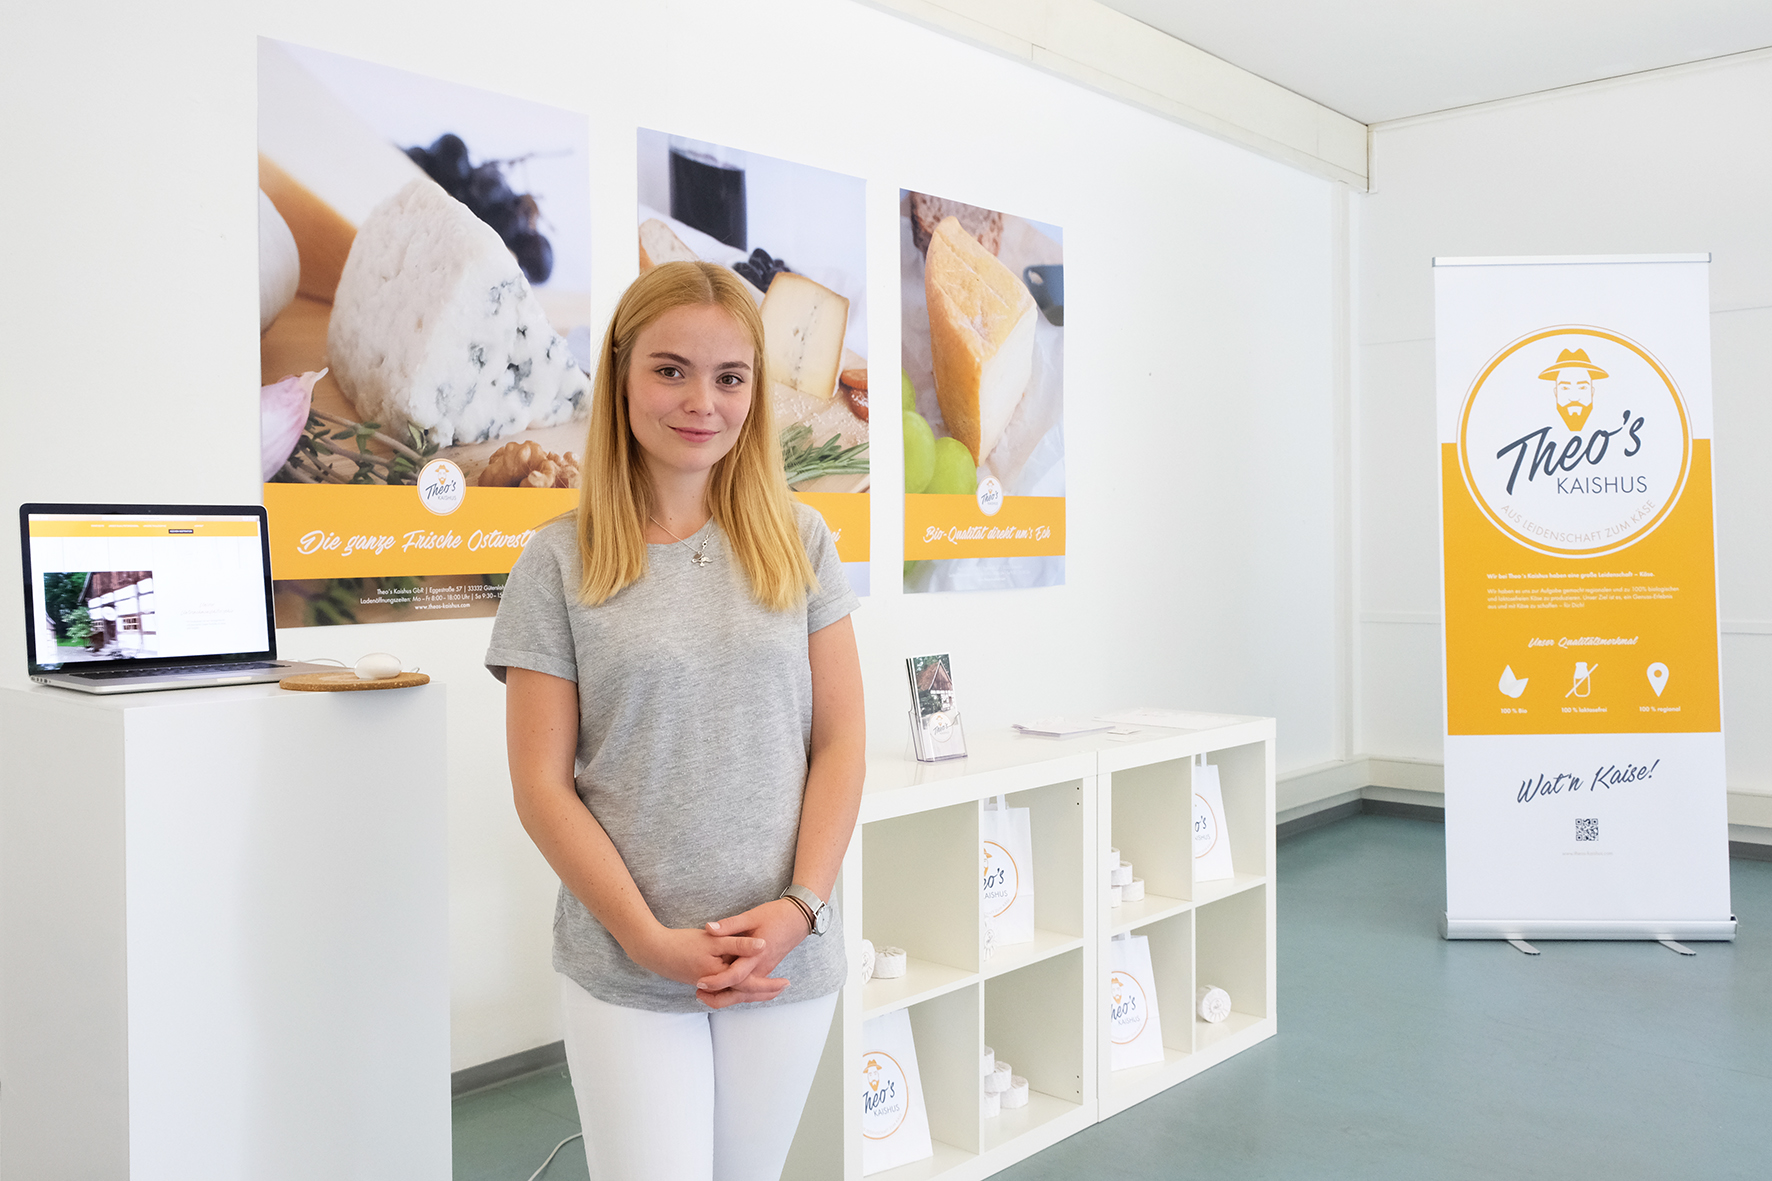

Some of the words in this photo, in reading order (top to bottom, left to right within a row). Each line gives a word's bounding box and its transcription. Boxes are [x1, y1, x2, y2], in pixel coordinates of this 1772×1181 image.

[1496, 409, 1645, 496] Theo's
[425, 479, 457, 500] Theo's
[1557, 475, 1648, 495] KAISHUS
[1500, 503, 1522, 524] AUS
[1522, 519, 1602, 543] LEIDENSCHAFT
[1604, 520, 1632, 538] ZUM
[1630, 499, 1656, 525] KÄSE
[297, 529, 342, 555] Die
[341, 535, 396, 557] ganze
[401, 529, 463, 552] Frische
[923, 525, 989, 545] Bio-Qualität
[987, 526, 1017, 539] direkt
[1528, 637, 1554, 648] Unser
[1516, 773, 1584, 803] Wat'n
[1590, 759, 1660, 792] Kaise!
[984, 890, 1008, 899] AISHUS
[1111, 995, 1136, 1023] heo's
[873, 1104, 900, 1117] KAISHUS
